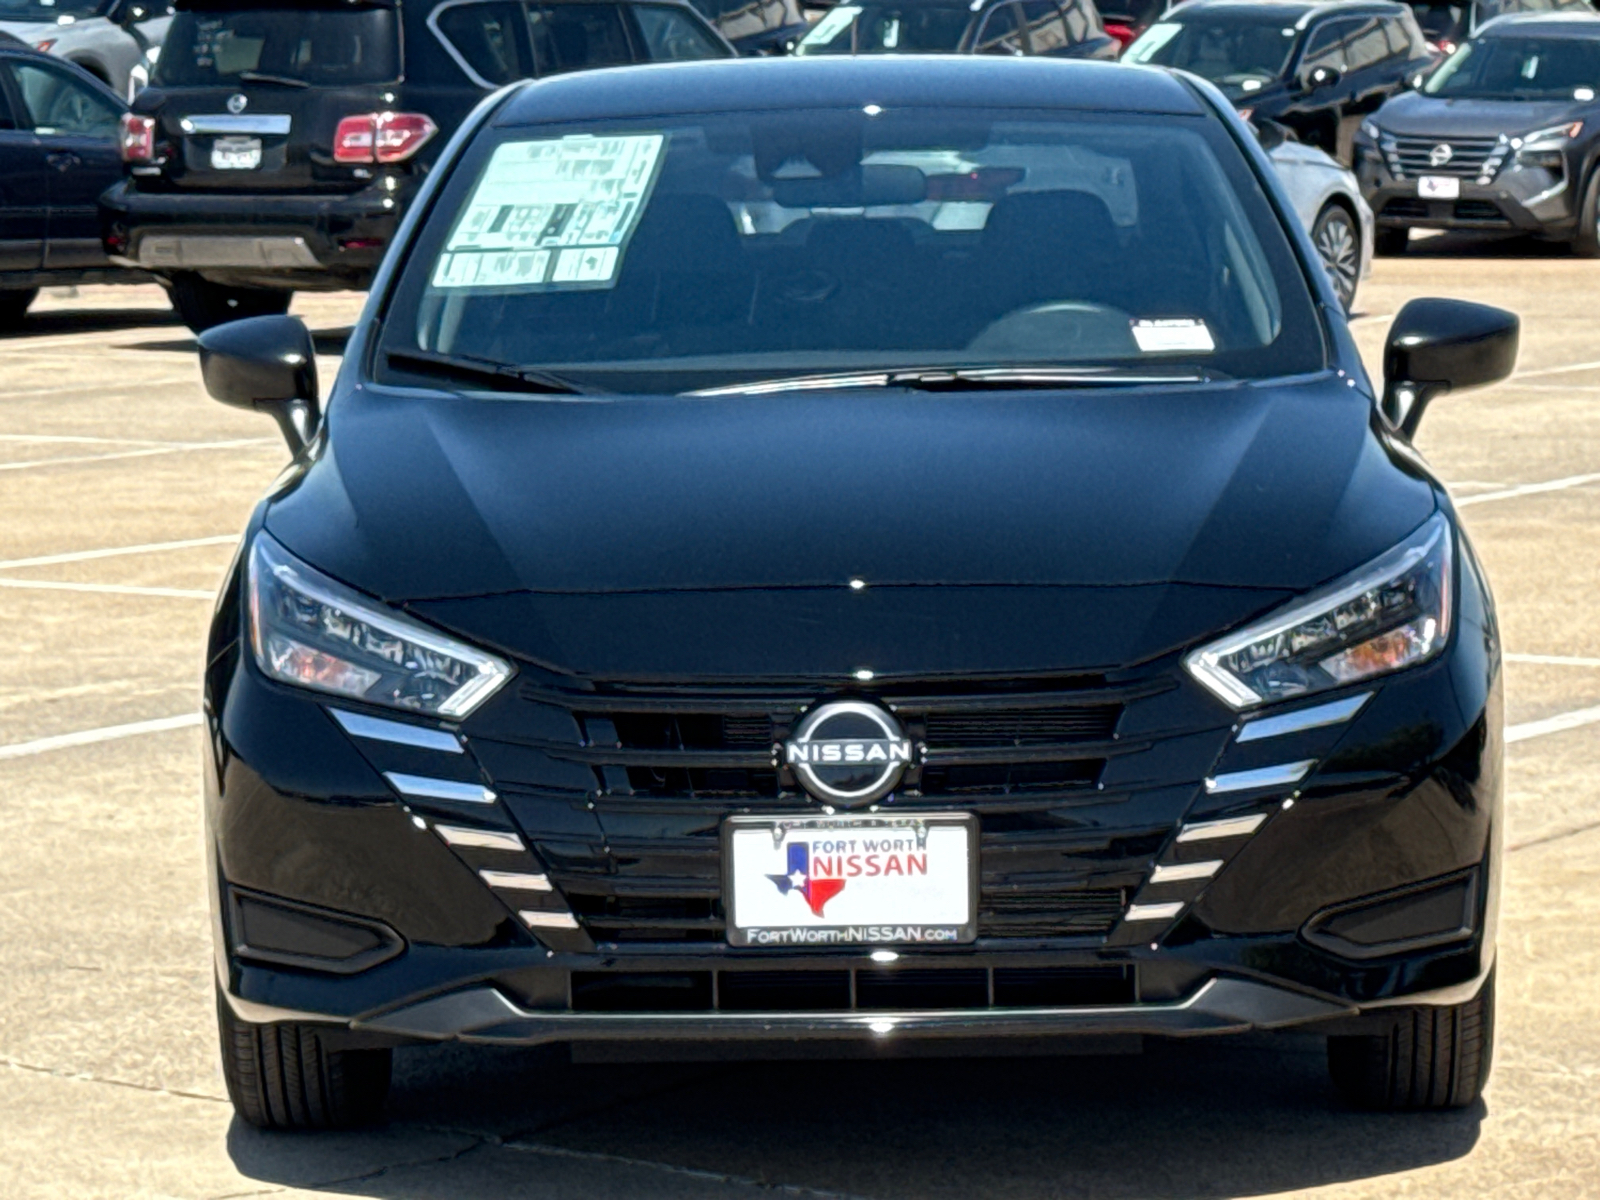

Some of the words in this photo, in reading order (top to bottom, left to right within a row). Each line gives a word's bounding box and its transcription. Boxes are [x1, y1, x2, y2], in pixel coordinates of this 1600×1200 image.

[788, 742, 910, 761] NISSAN
[812, 840, 857, 853] FORT
[863, 839, 926, 852] WORTH
[813, 854, 928, 876] NISSAN
